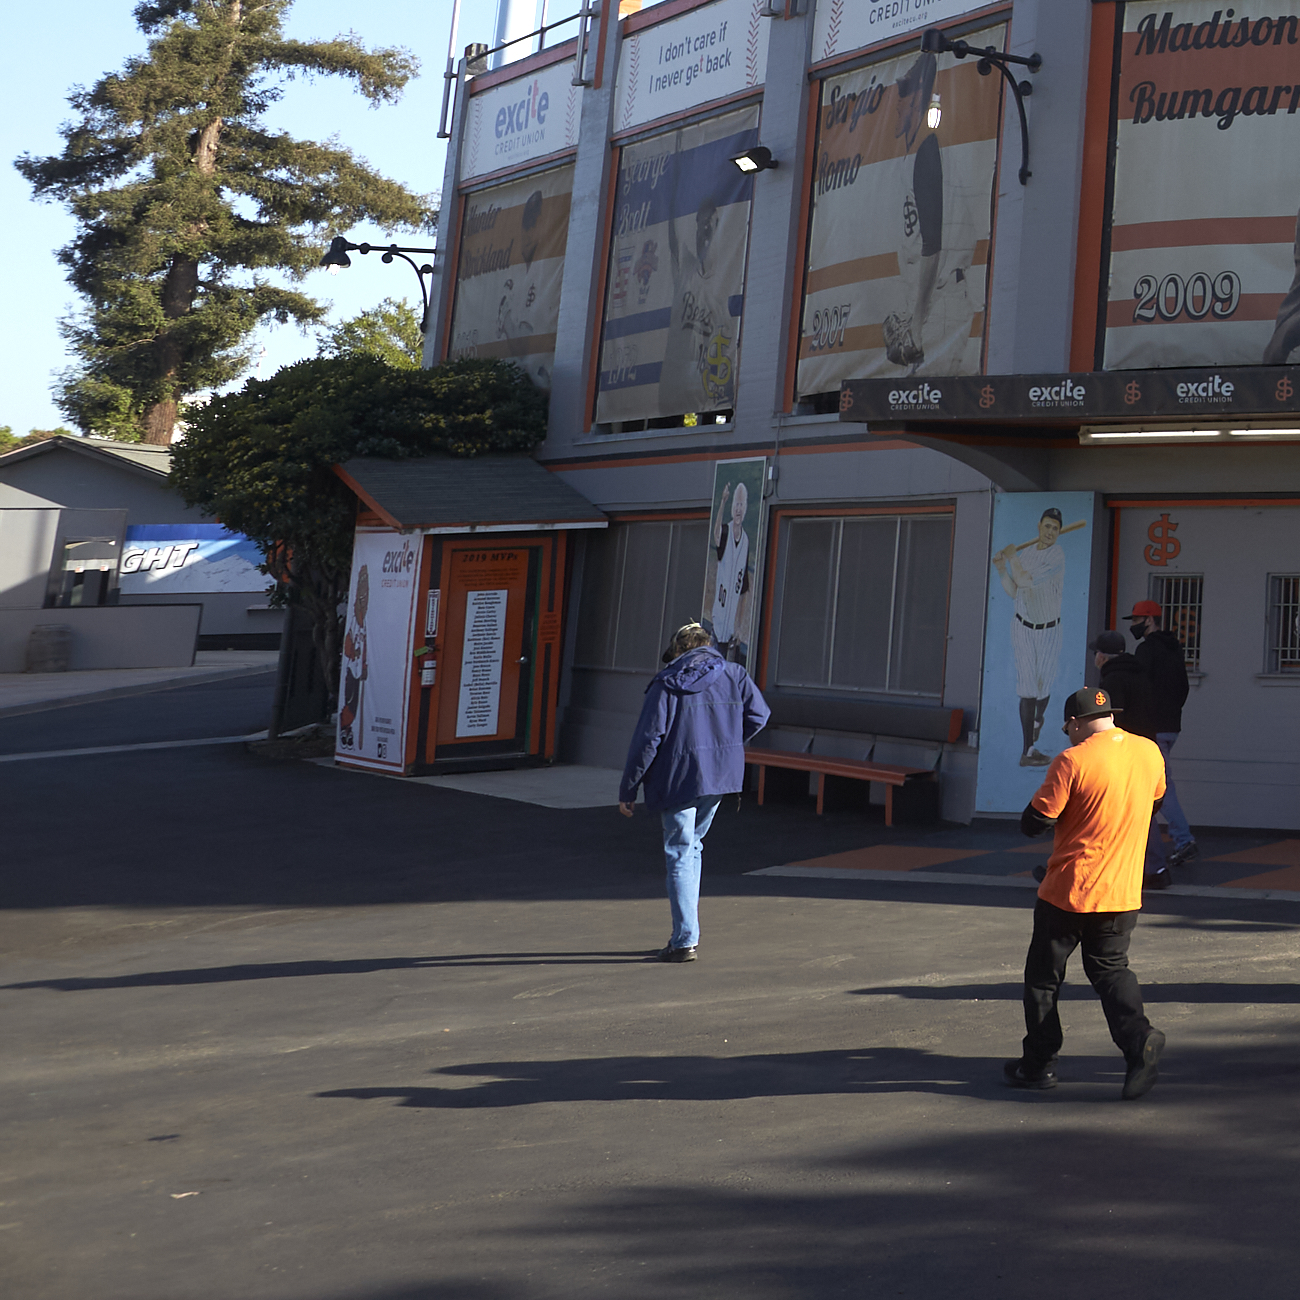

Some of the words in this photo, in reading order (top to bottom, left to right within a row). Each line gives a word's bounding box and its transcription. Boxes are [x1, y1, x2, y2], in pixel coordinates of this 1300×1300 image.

[693, 31, 716, 53] care
[719, 21, 728, 42] if
[1134, 8, 1299, 56] Madison
[655, 68, 684, 91] never
[685, 55, 703, 86] get
[705, 48, 732, 74] back
[495, 79, 549, 138] excite
[826, 76, 888, 133] Sergio
[1132, 269, 1242, 324] 2009
[809, 303, 851, 352] 2007
[888, 382, 942, 405] excite
[1029, 378, 1086, 402] excite
[1176, 374, 1234, 397] excite
